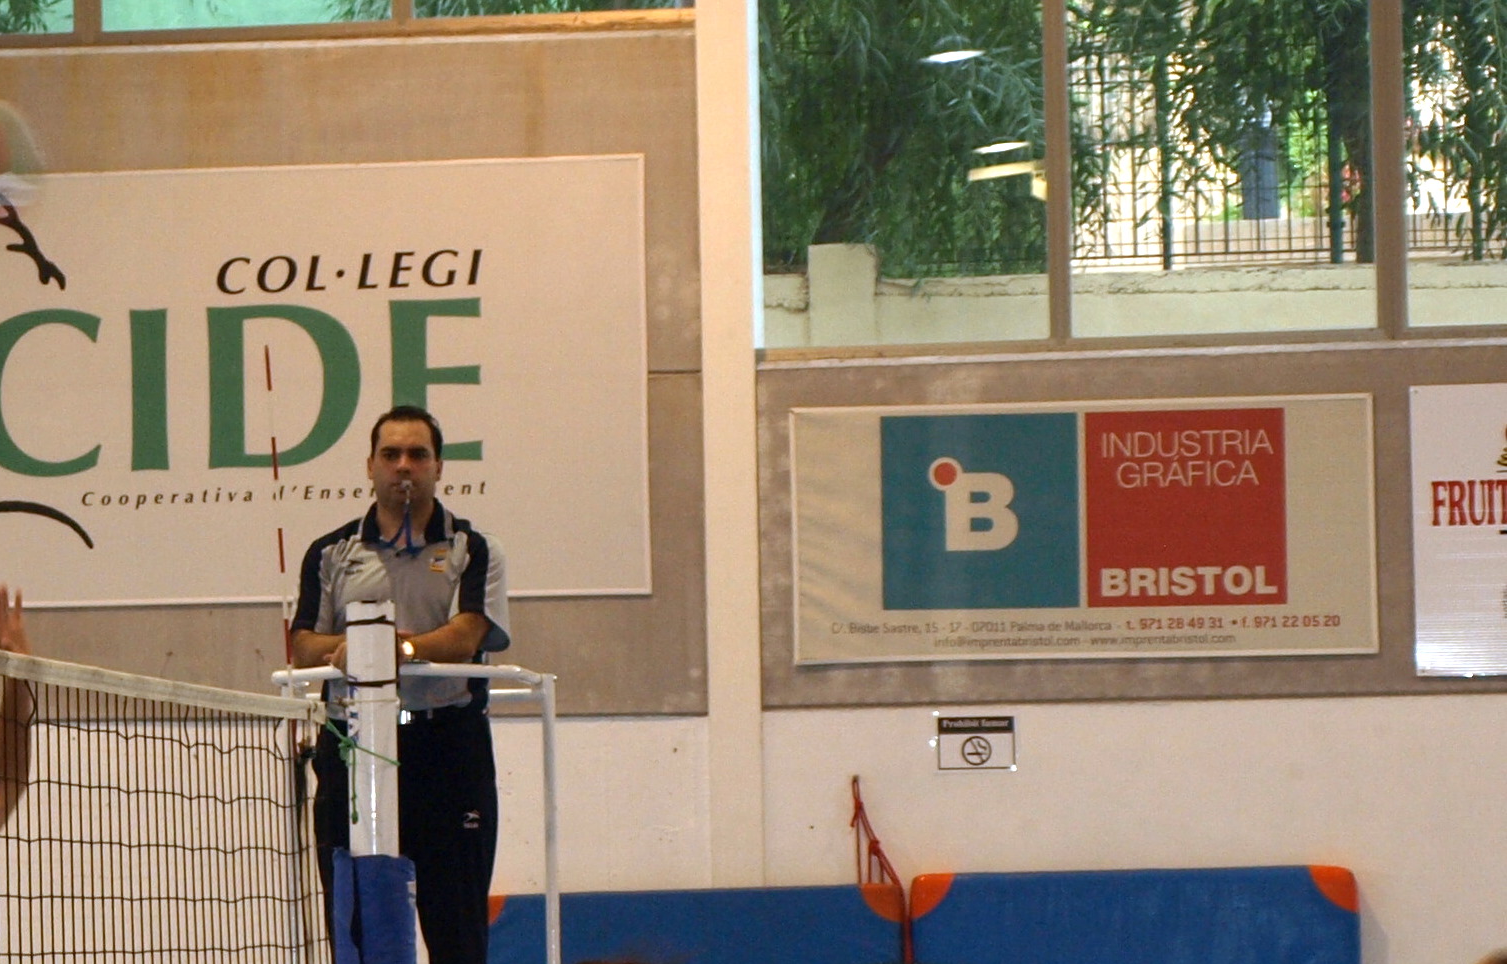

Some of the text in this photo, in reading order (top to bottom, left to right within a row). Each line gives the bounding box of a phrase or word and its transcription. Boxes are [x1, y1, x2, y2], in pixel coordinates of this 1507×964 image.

[1101, 428, 1274, 459] INDUSTRIA
[1116, 455, 1259, 489] GRÁFICA
[81, 486, 254, 510] Cooperativa
[1100, 565, 1278, 597] BRISTOL
[1010, 620, 1044, 632] Palma
[1047, 620, 1063, 632] de
[1282, 615, 1300, 628] 22
